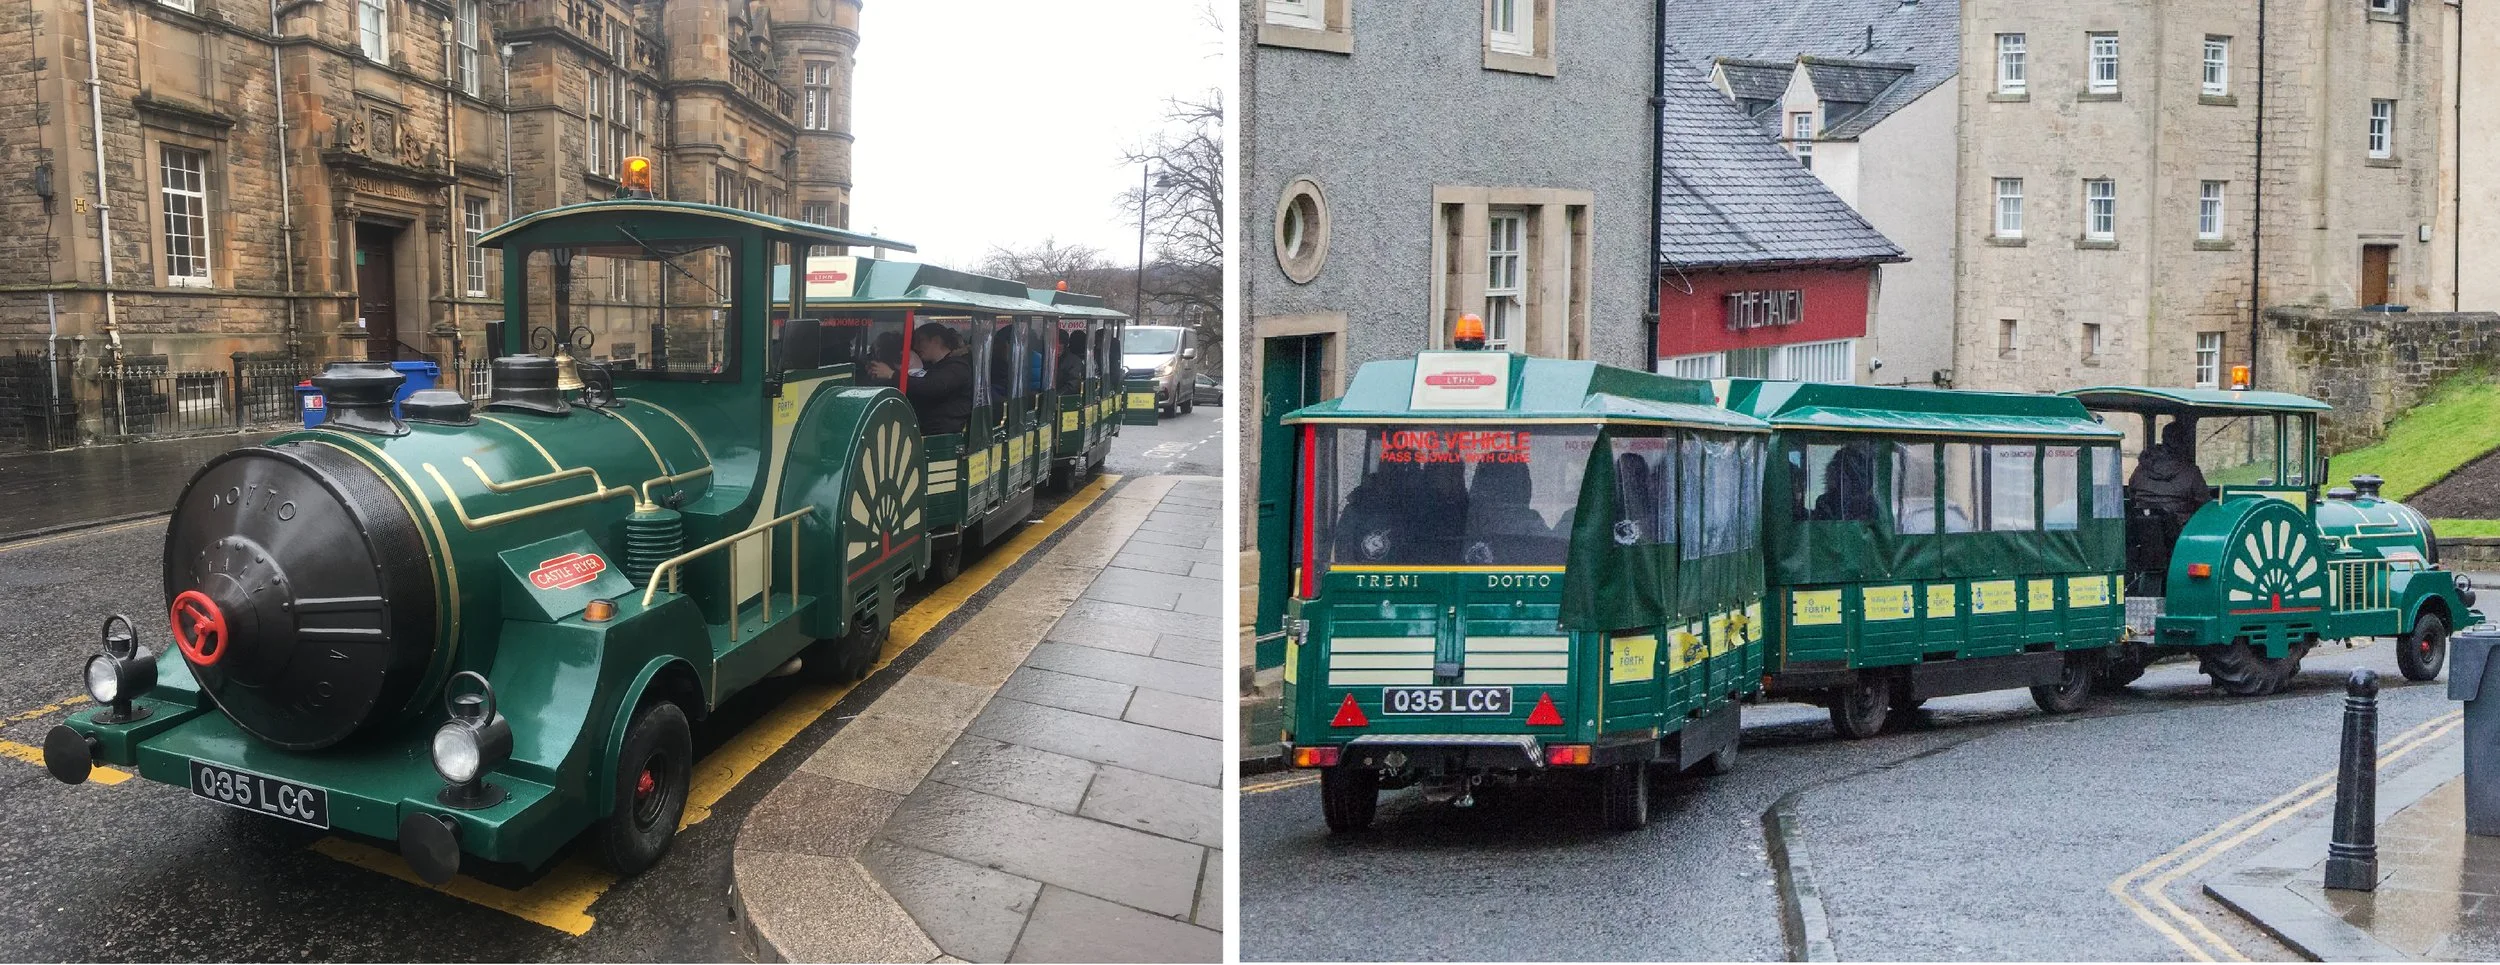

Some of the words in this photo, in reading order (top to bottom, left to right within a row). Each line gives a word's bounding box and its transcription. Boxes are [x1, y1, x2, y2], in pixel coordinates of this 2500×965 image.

[384, 182, 420, 200] LIBRAR
[1729, 290, 1761, 330] THE
[1762, 288, 1805, 326] HAVEN
[1381, 430, 1440, 450] LONG
[1443, 430, 1532, 451] VEHICLE
[1381, 450, 1412, 463] PASS
[1414, 450, 1460, 463] SLOWLY
[1497, 451, 1532, 463] CARE
[212, 484, 296, 521] DOTTO
[536, 566, 573, 584] CASTLE
[572, 557, 601, 574] FLYER
[1356, 575, 1419, 588] TRENI
[1487, 575, 1551, 588] DOTTO
[1803, 605, 1831, 614] FORTH
[1620, 655, 1645, 666] FORTH
[1450, 689, 1502, 712] LCC
[258, 779, 316, 820] LCC
